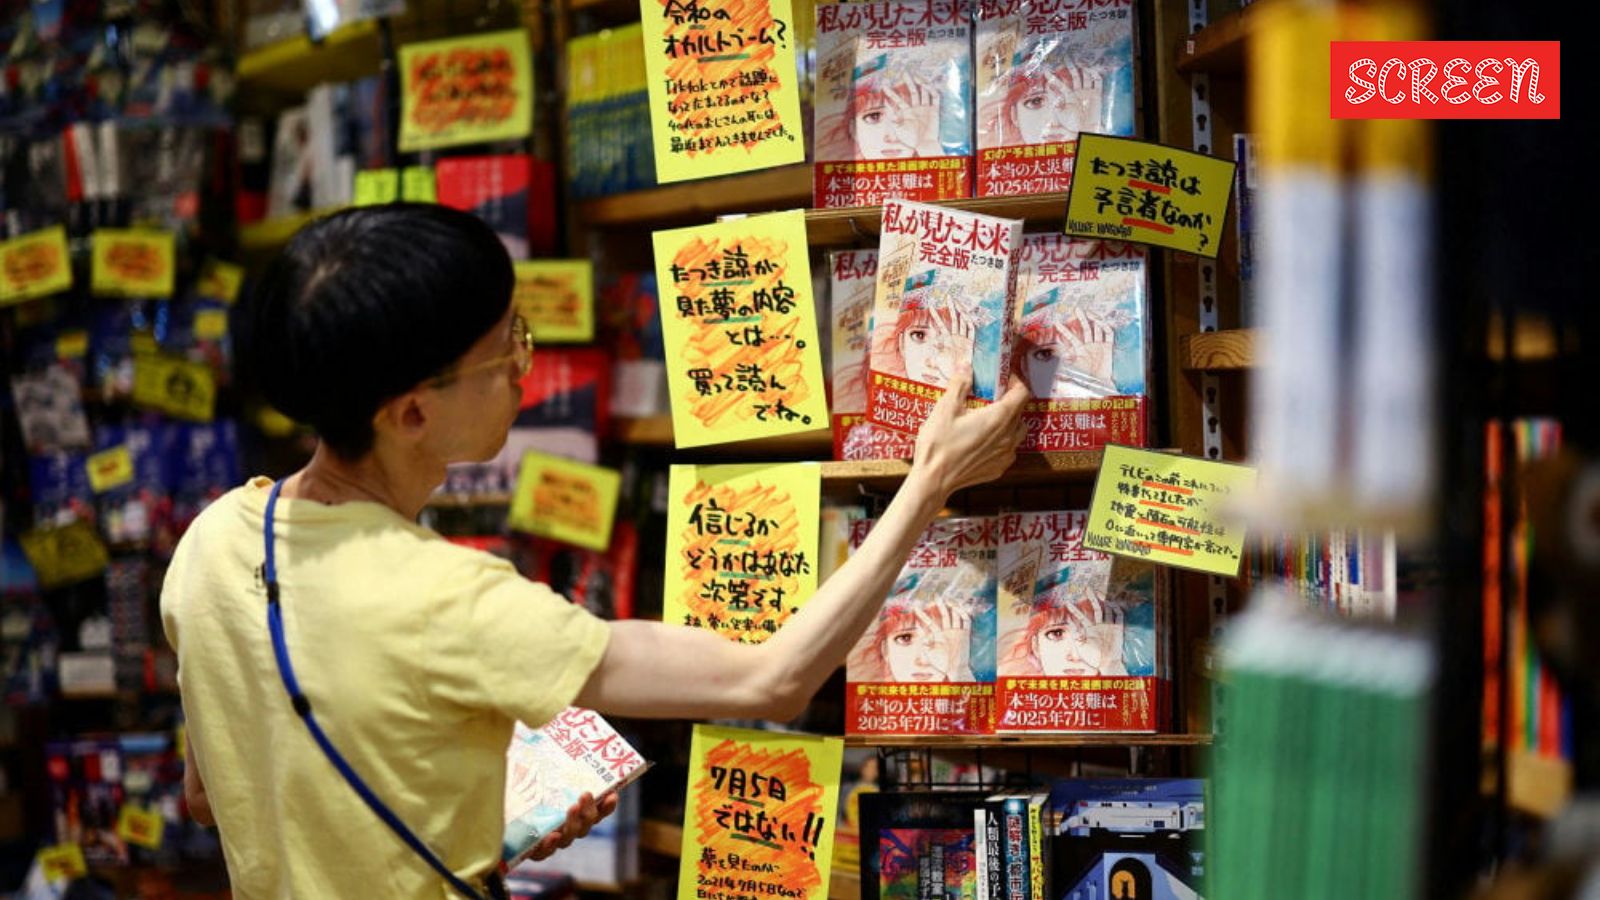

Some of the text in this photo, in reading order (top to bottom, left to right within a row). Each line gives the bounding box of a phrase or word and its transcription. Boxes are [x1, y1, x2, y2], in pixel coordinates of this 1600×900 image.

[664, 0, 731, 26] 令和の
[817, 0, 969, 33] 私が見た未来
[1026, 11, 1088, 35] 完全版
[866, 28, 927, 49] 完全版
[882, 202, 1010, 255] 私が見た未来
[919, 242, 971, 270] 完全版
[1038, 262, 1100, 283] 完全版
[676, 280, 797, 320] 見た夢の内容
[688, 363, 786, 396] 買って読ん
[753, 400, 812, 425] でね。
[689, 498, 780, 536] 信じるか
[687, 548, 810, 577] どうかはあなた
[710, 766, 786, 802] 7月5日
